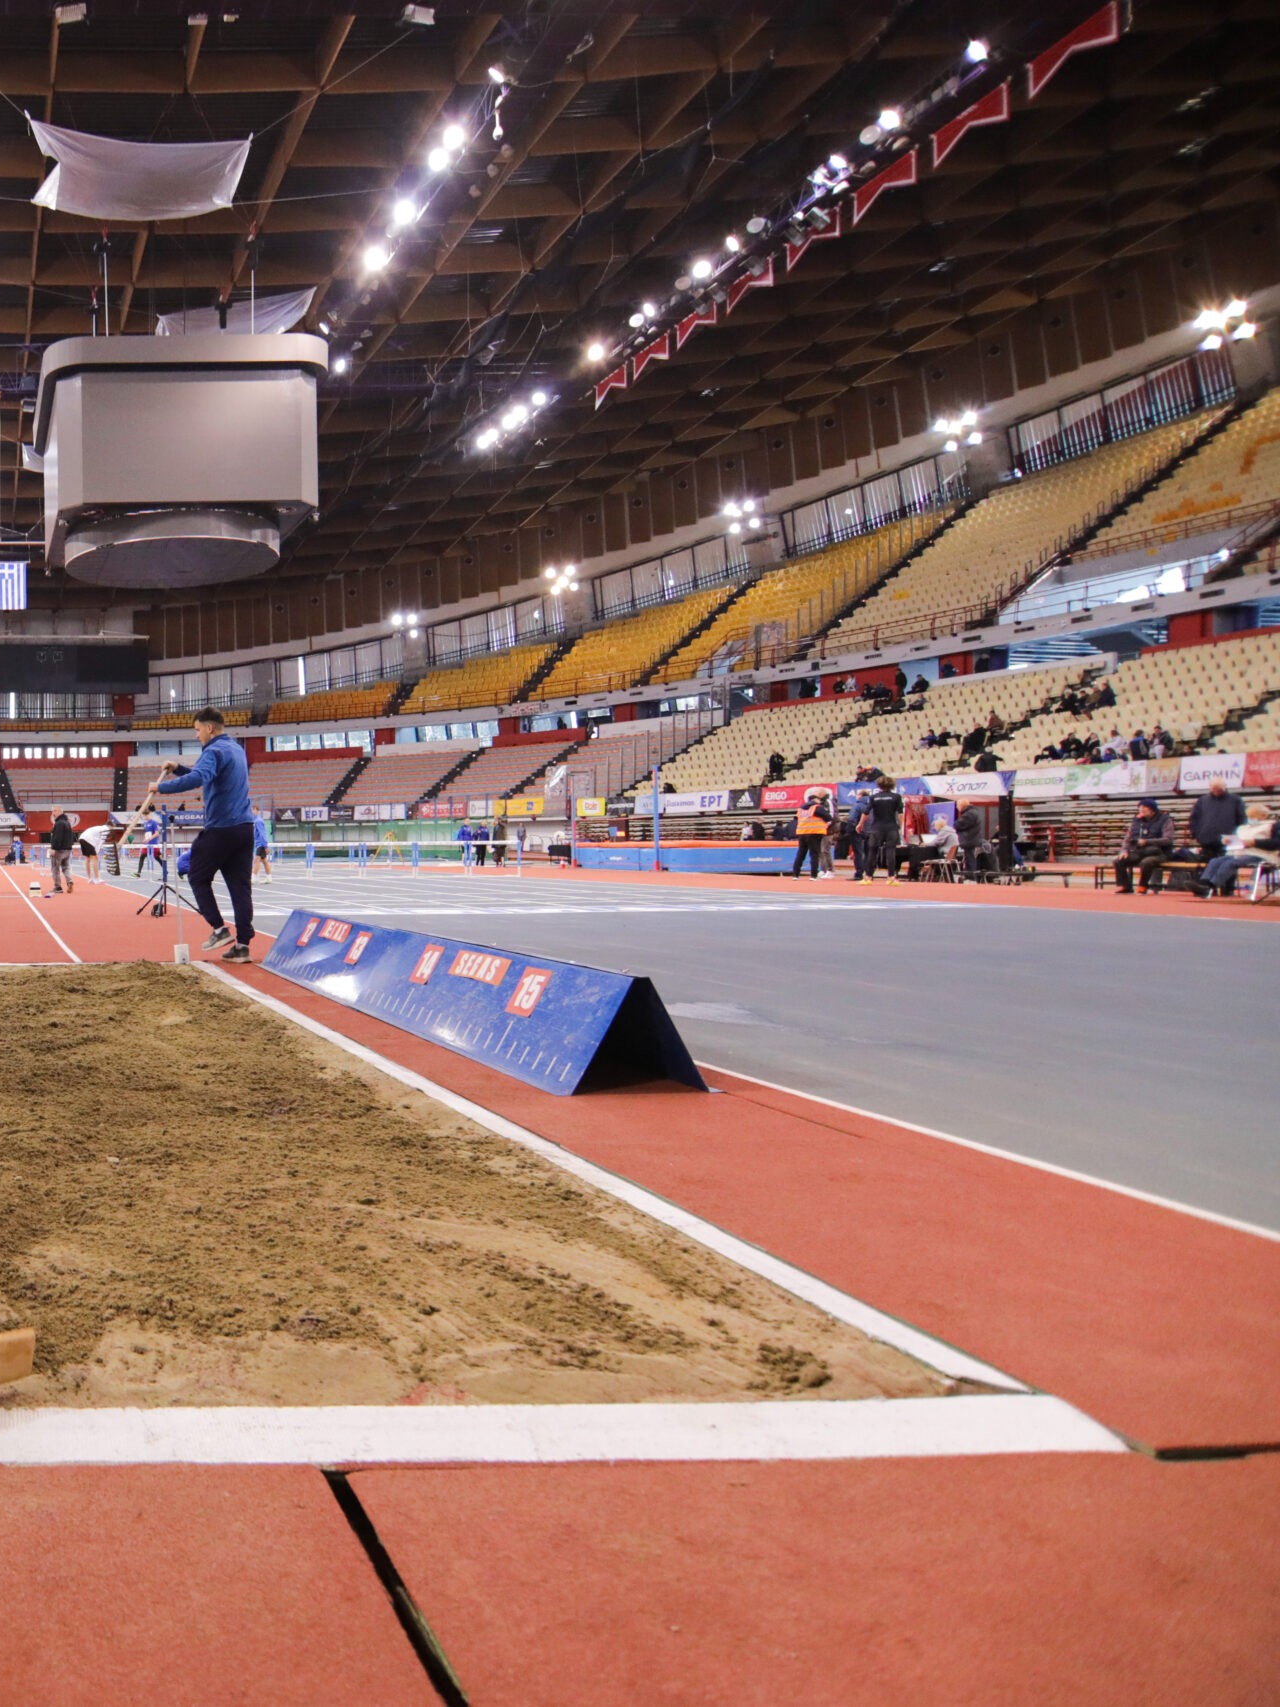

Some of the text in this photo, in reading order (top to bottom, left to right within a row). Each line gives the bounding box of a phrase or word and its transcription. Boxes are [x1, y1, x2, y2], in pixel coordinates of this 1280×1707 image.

[1183, 769, 1240, 782] GARMIN
[349, 935, 369, 960] 13
[415, 949, 441, 979] 14
[455, 952, 502, 981] SEGAS
[513, 973, 547, 1010] 15
